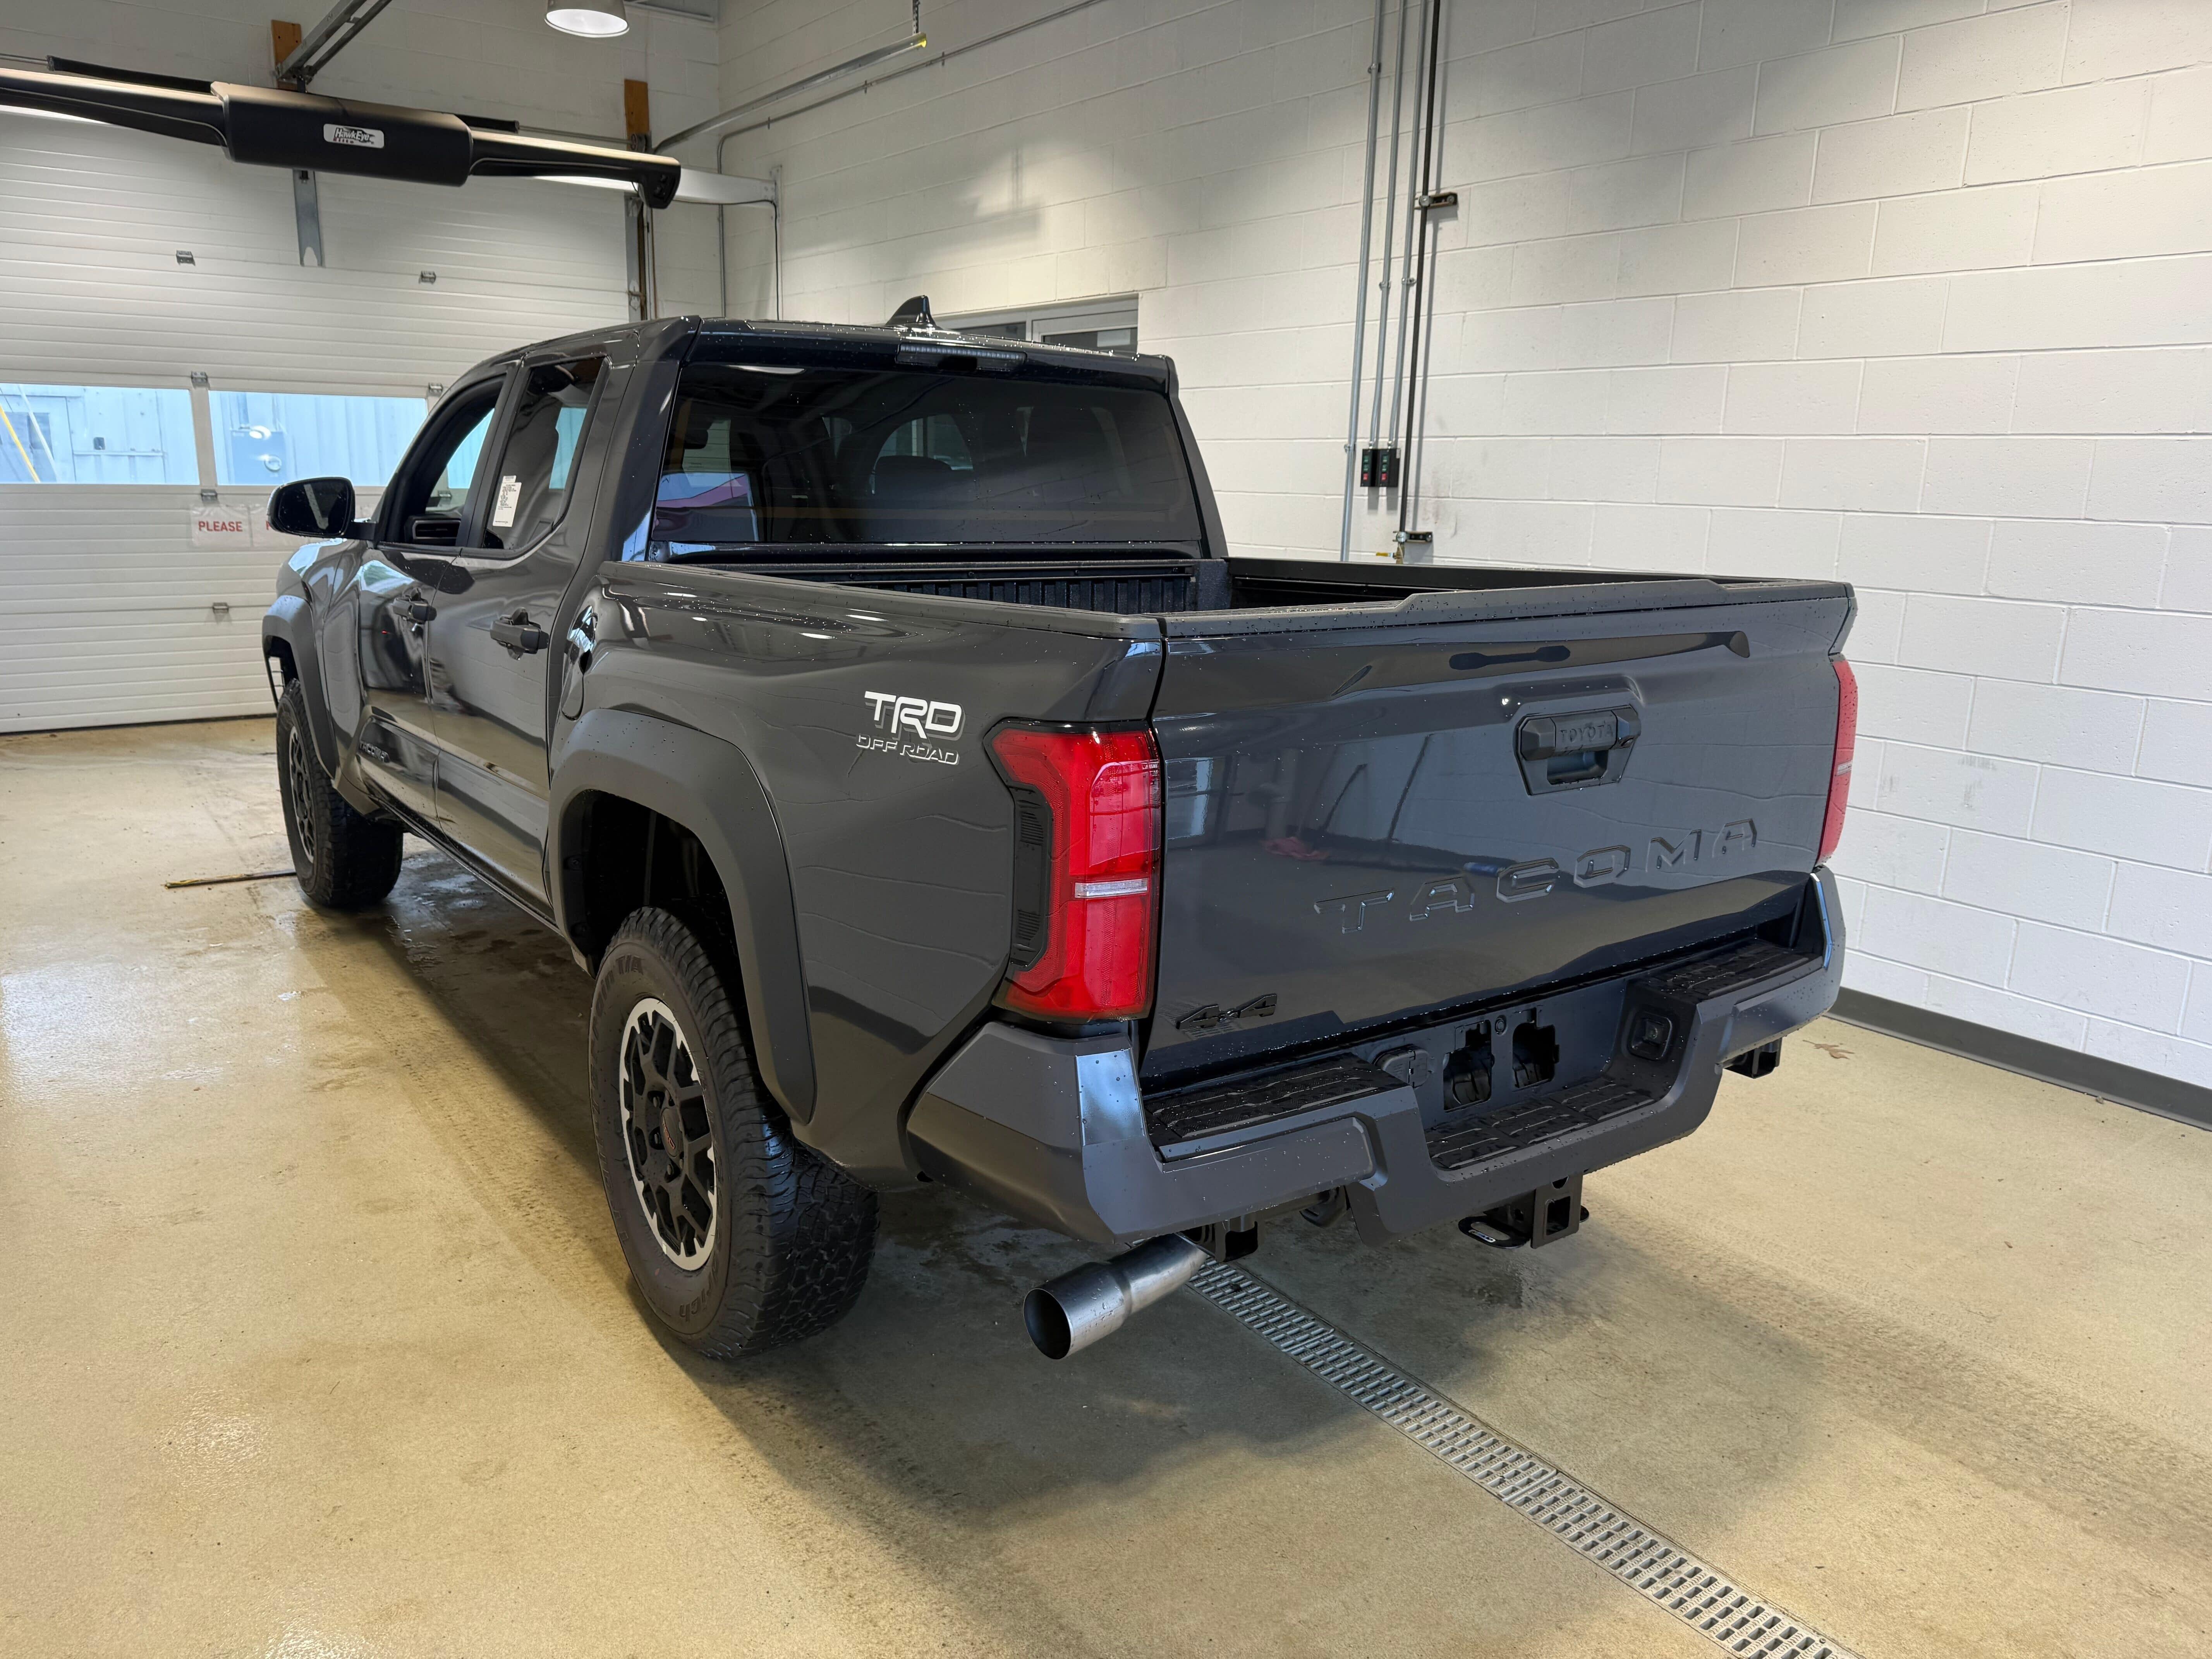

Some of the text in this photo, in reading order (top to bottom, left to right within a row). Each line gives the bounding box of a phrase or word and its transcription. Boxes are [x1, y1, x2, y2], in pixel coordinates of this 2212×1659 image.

[334, 127, 370, 143] HawkEye
[198, 520, 243, 532] PLEASE
[864, 691, 965, 741] TRD
[1558, 723, 1613, 743] TOYOTA
[855, 733, 960, 766] OFF ROAD
[1314, 818, 1758, 934] TACOMA
